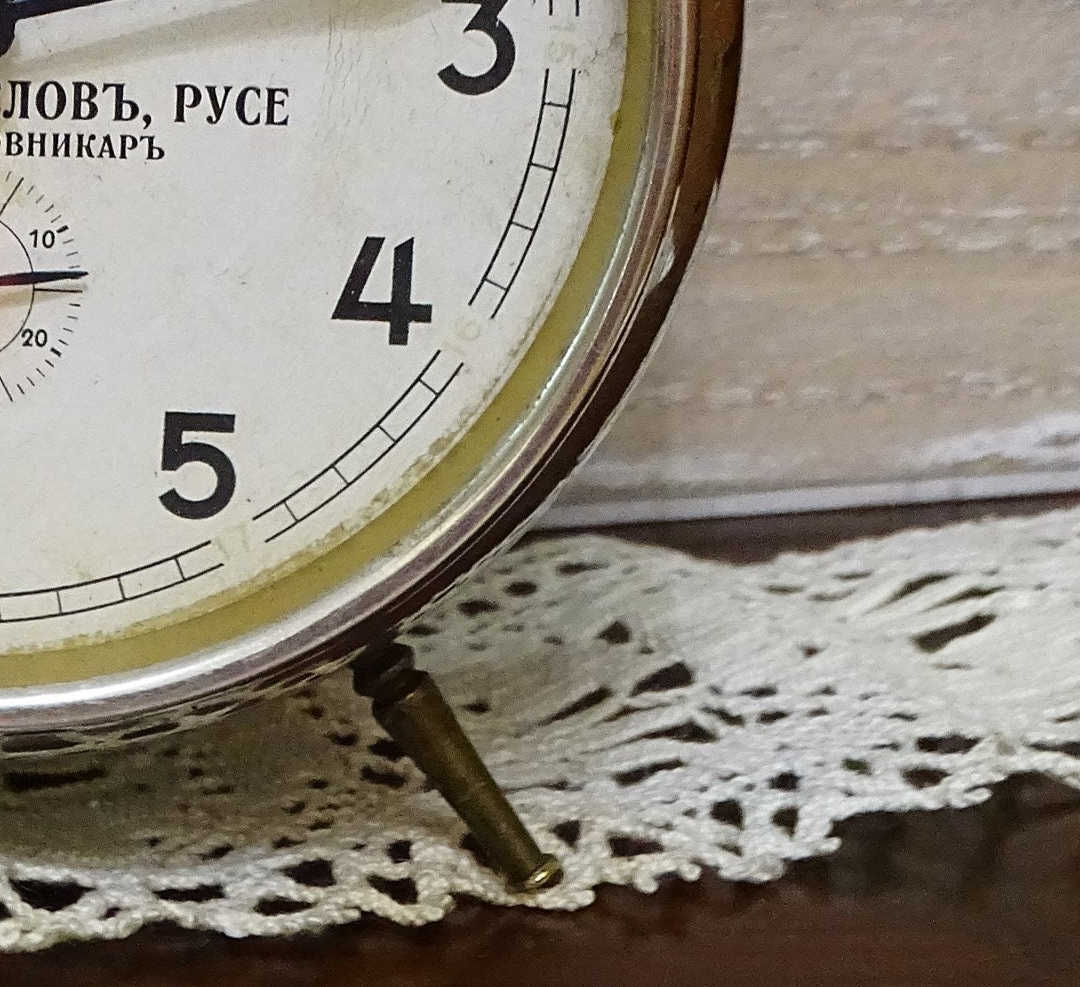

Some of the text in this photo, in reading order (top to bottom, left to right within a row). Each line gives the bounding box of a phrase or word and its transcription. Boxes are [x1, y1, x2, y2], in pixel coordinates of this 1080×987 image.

[173, 83, 289, 126] РУСЕ
[29, 229, 56, 249] 10
[330, 236, 433, 347] 4
[21, 328, 48, 348] 20
[158, 411, 237, 520] 5
